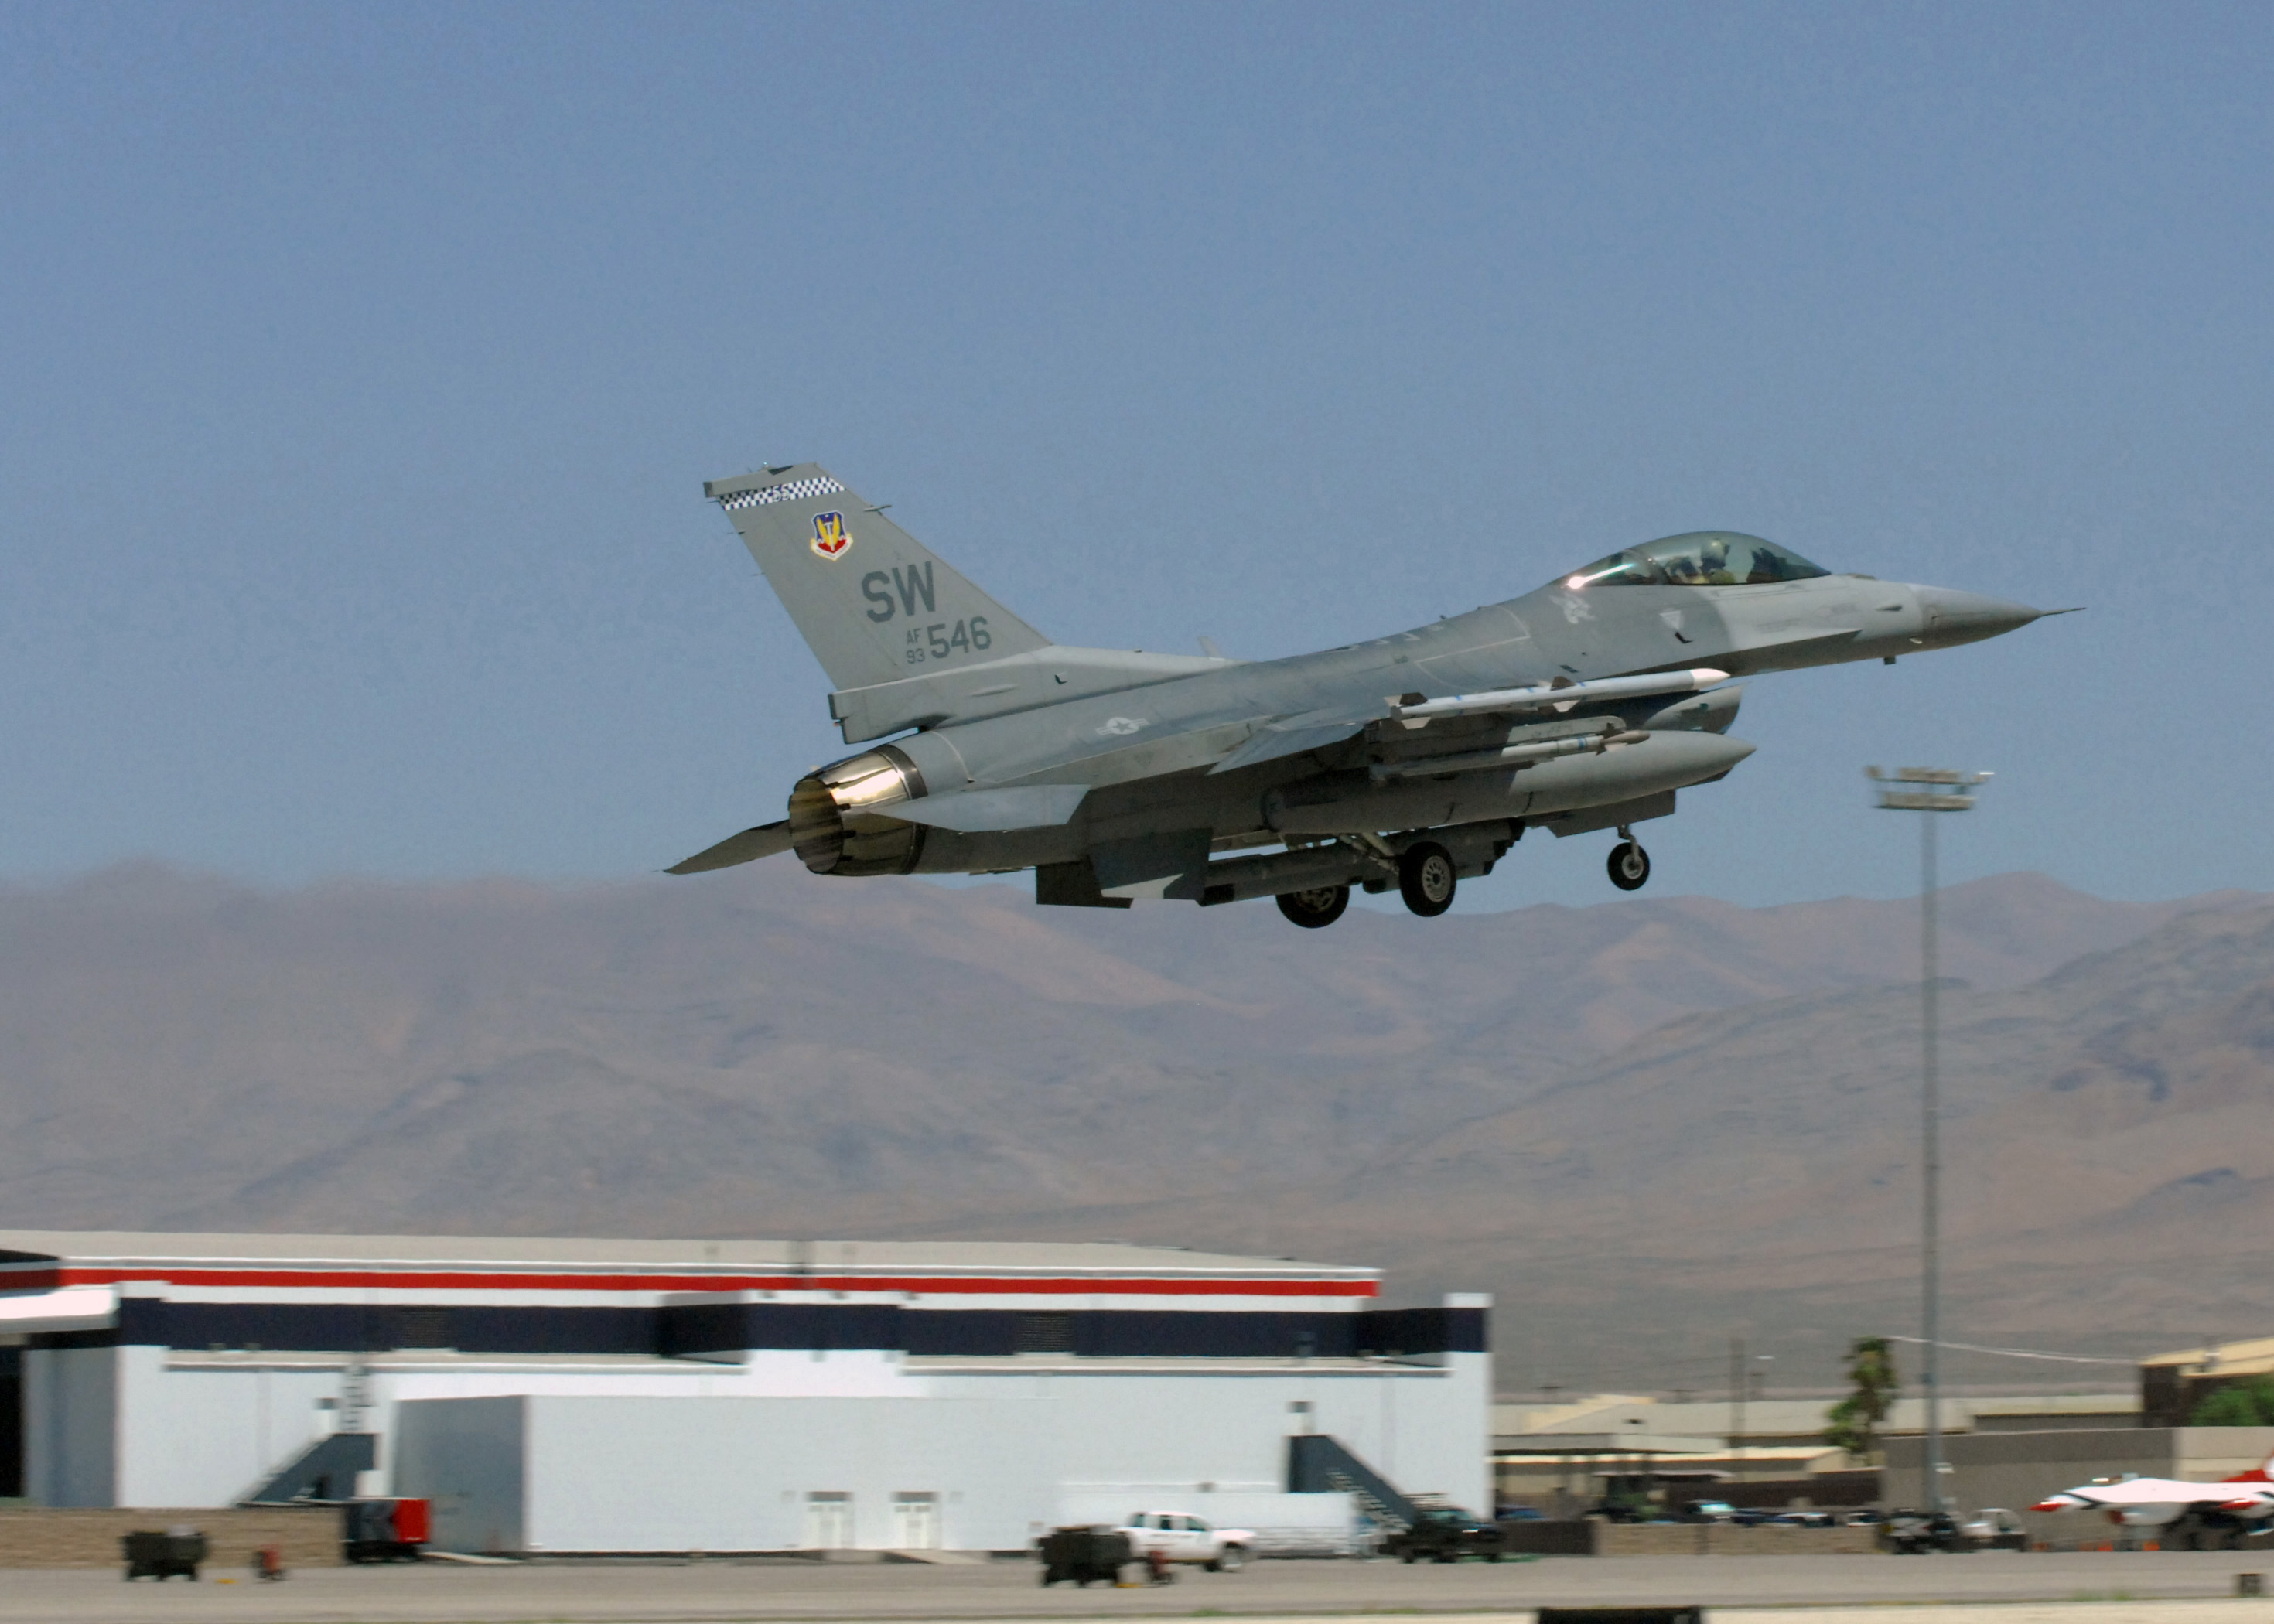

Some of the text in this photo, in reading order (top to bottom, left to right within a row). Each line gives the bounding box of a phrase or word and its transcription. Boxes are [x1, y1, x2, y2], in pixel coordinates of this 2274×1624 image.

[861, 561, 935, 623] SW
[906, 627, 922, 645] AF
[927, 616, 992, 658] 546
[906, 648, 925, 664] 93
